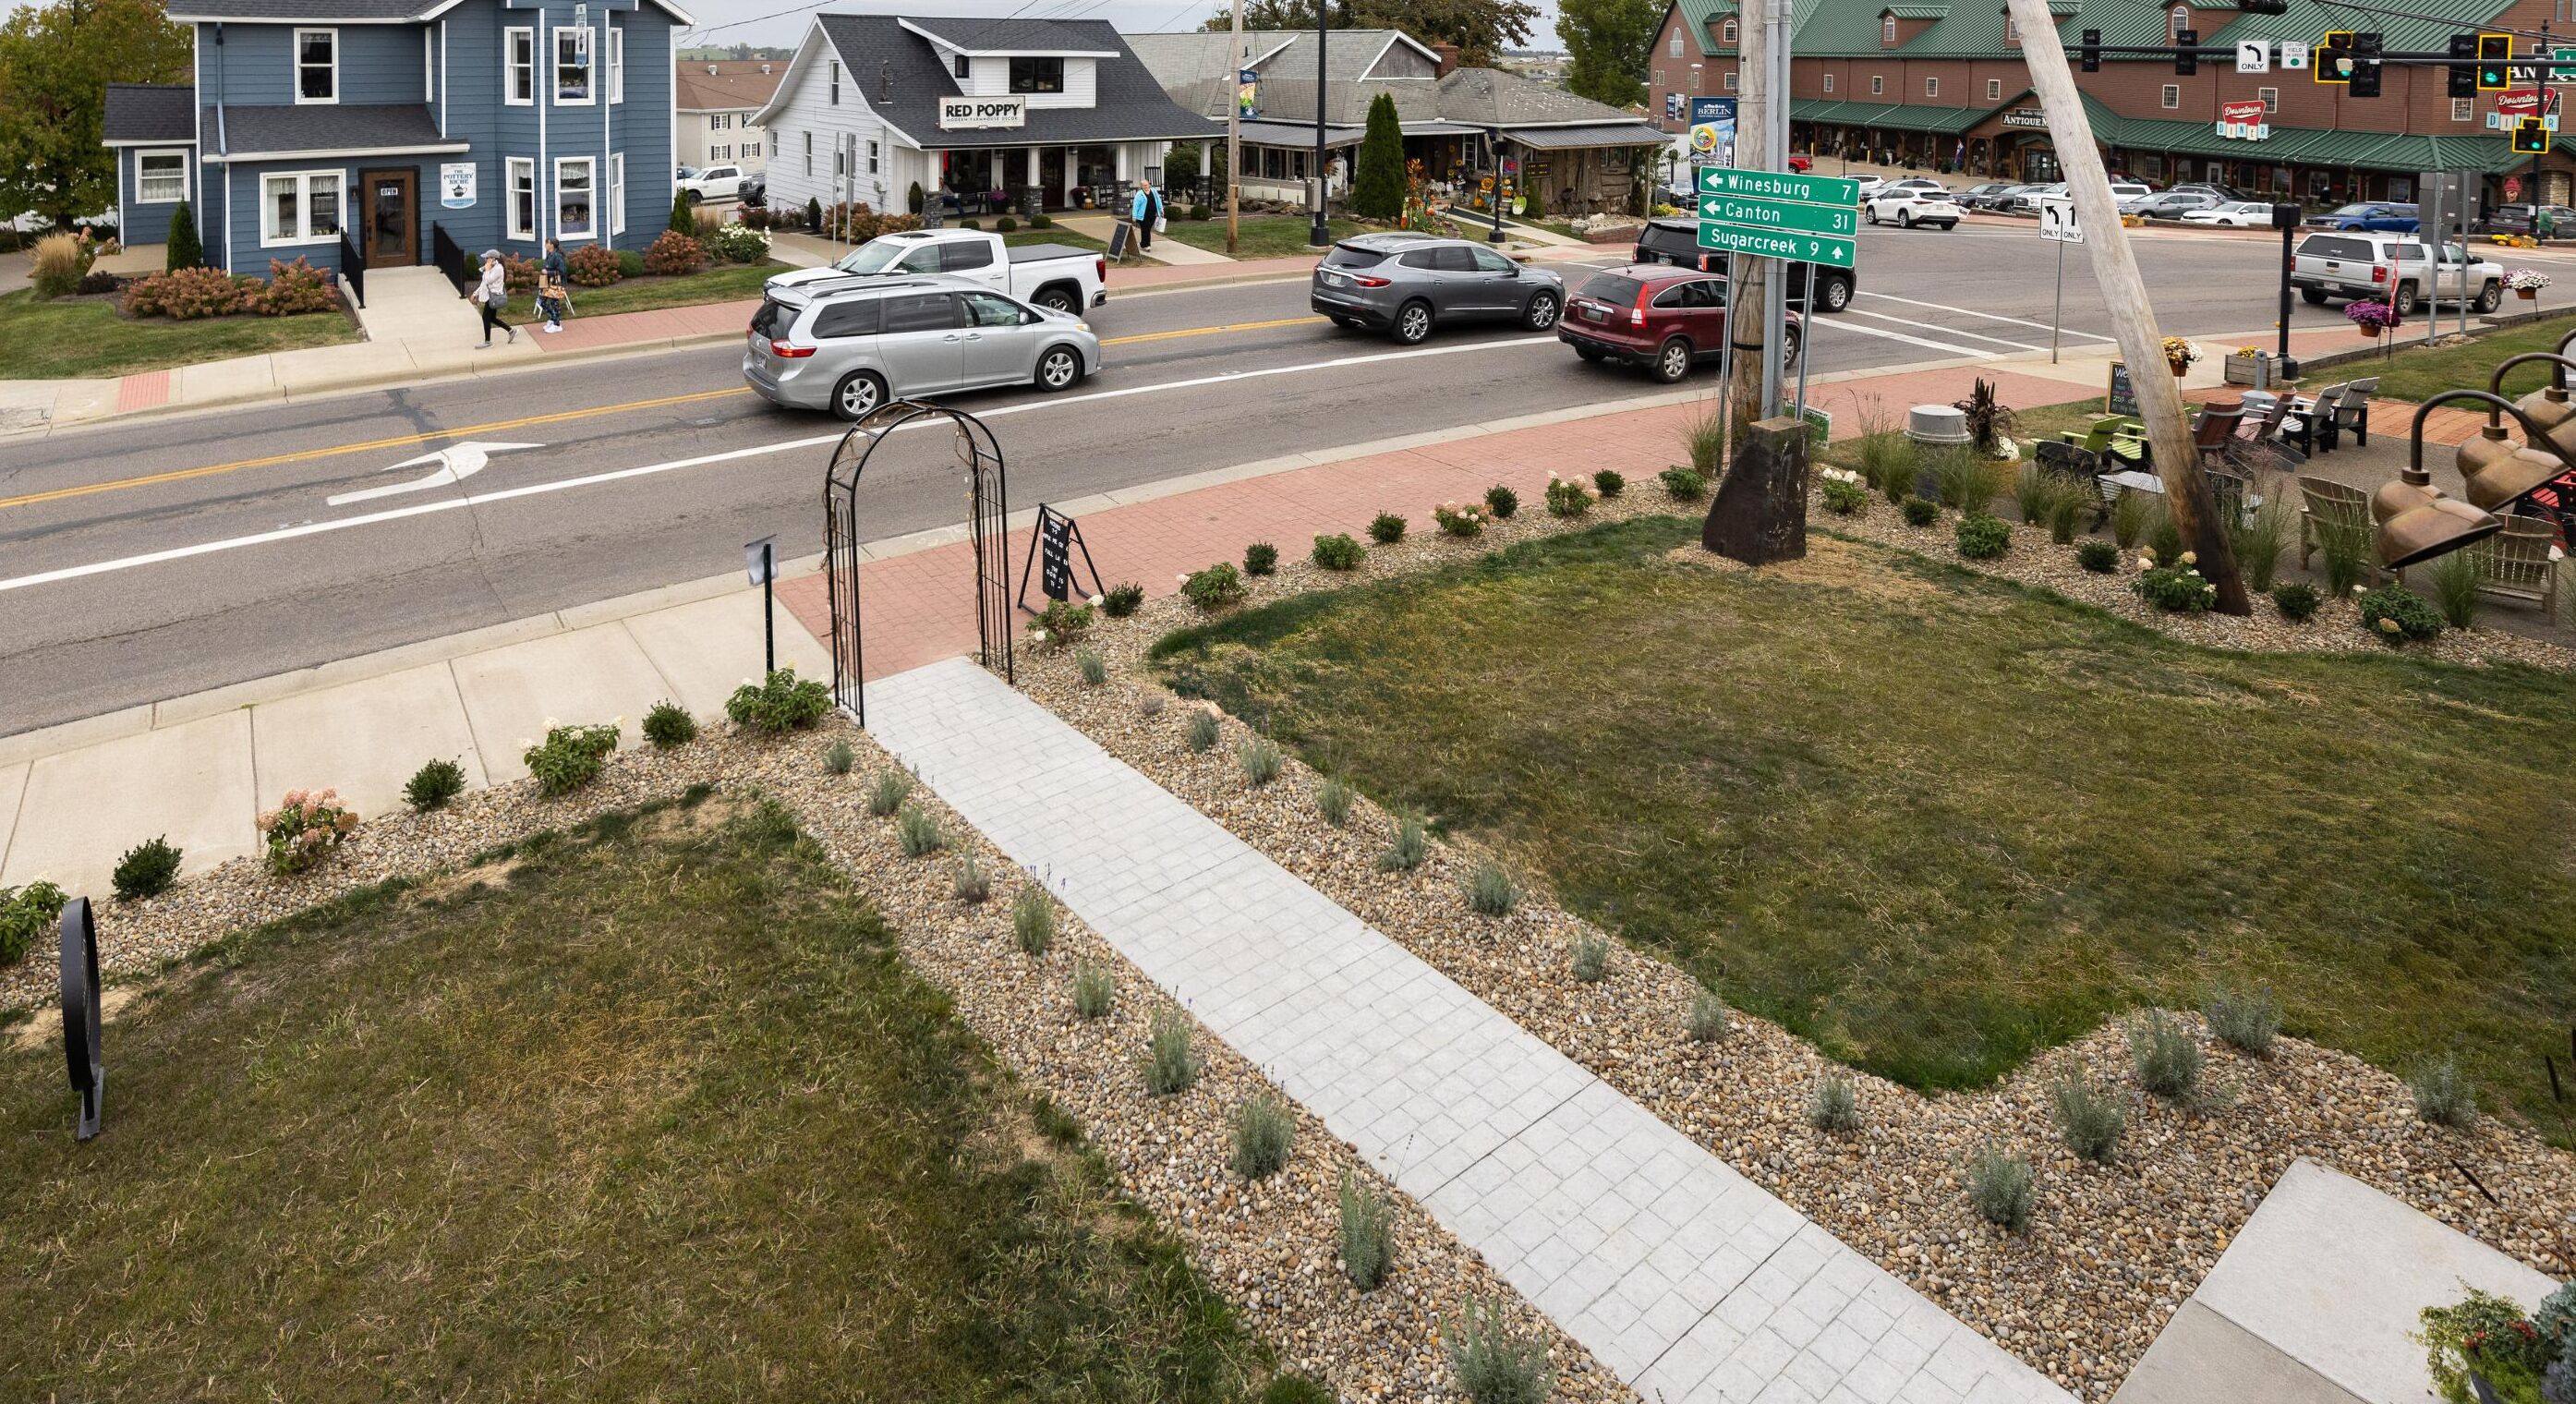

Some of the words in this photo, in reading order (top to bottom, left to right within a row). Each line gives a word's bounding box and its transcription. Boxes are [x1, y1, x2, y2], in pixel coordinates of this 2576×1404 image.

[946, 104, 973, 117] RED
[976, 103, 1021, 117] POPPY
[2224, 105, 2262, 115] Downtown
[2219, 123, 2266, 138] DINER
[1727, 174, 1810, 200] Winesburg
[1842, 185, 1851, 200] 7
[1725, 202, 1781, 223] Canton
[1832, 213, 1848, 230] 31
[2042, 228, 2059, 236] ONLY
[2063, 231, 2081, 239] ONLY
[1711, 228, 1797, 254] Sugarcreek
[1809, 240, 1820, 256] 9
